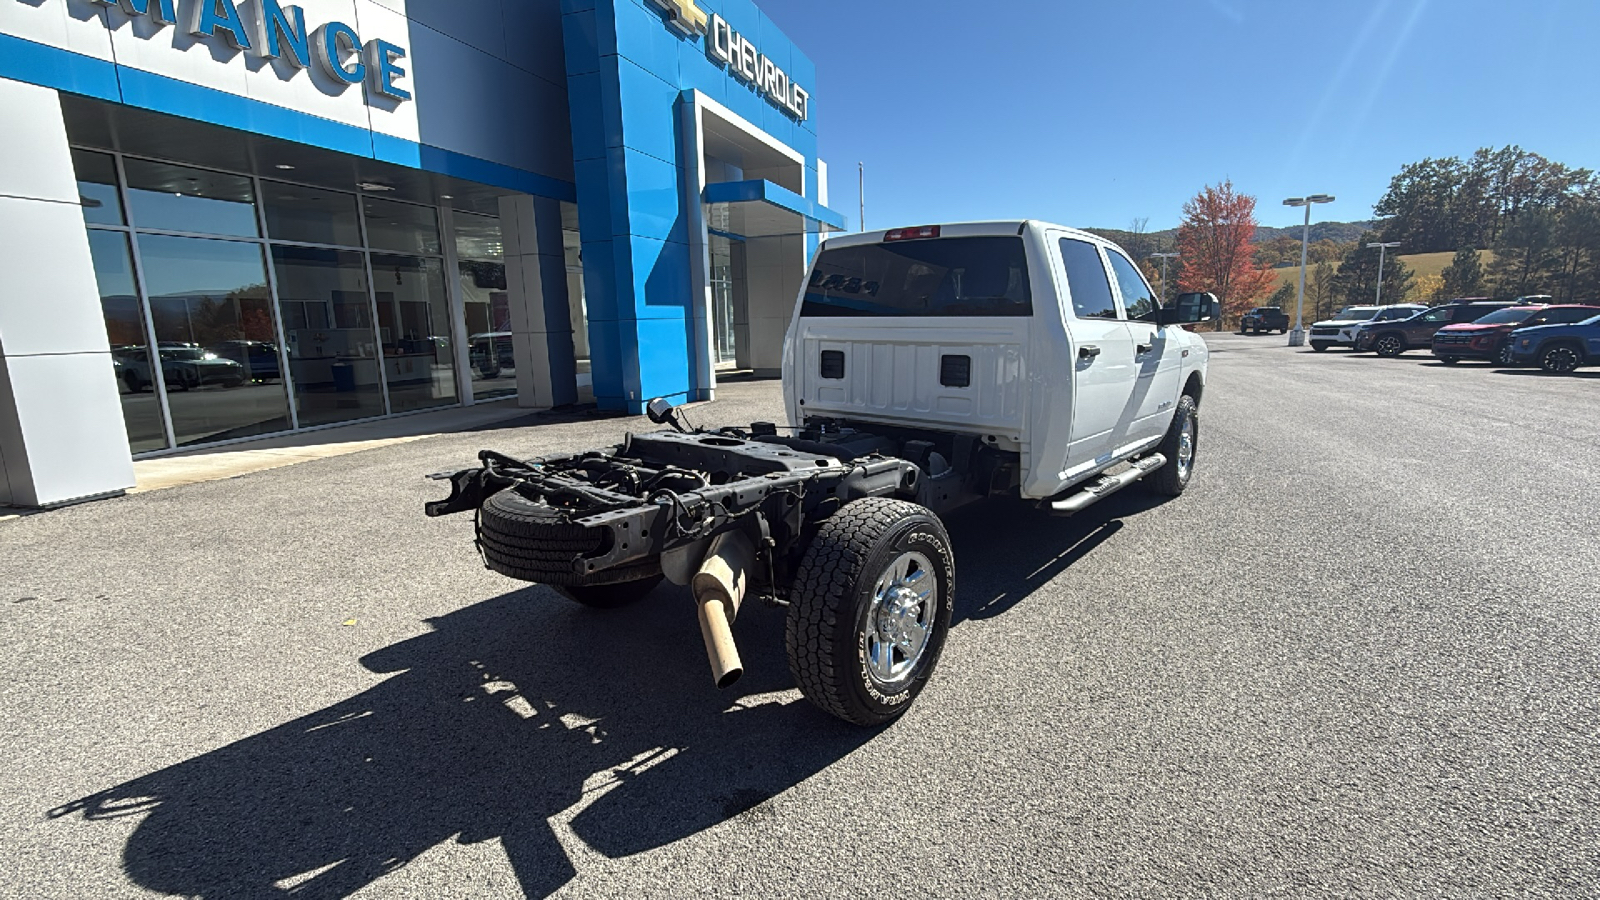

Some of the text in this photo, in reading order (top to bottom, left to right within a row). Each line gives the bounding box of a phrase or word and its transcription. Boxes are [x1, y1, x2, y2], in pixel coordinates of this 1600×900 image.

[711, 12, 810, 121] CHEVROLET
[907, 532, 953, 611] GOODYEAR
[858, 631, 911, 706] WRANGLER
